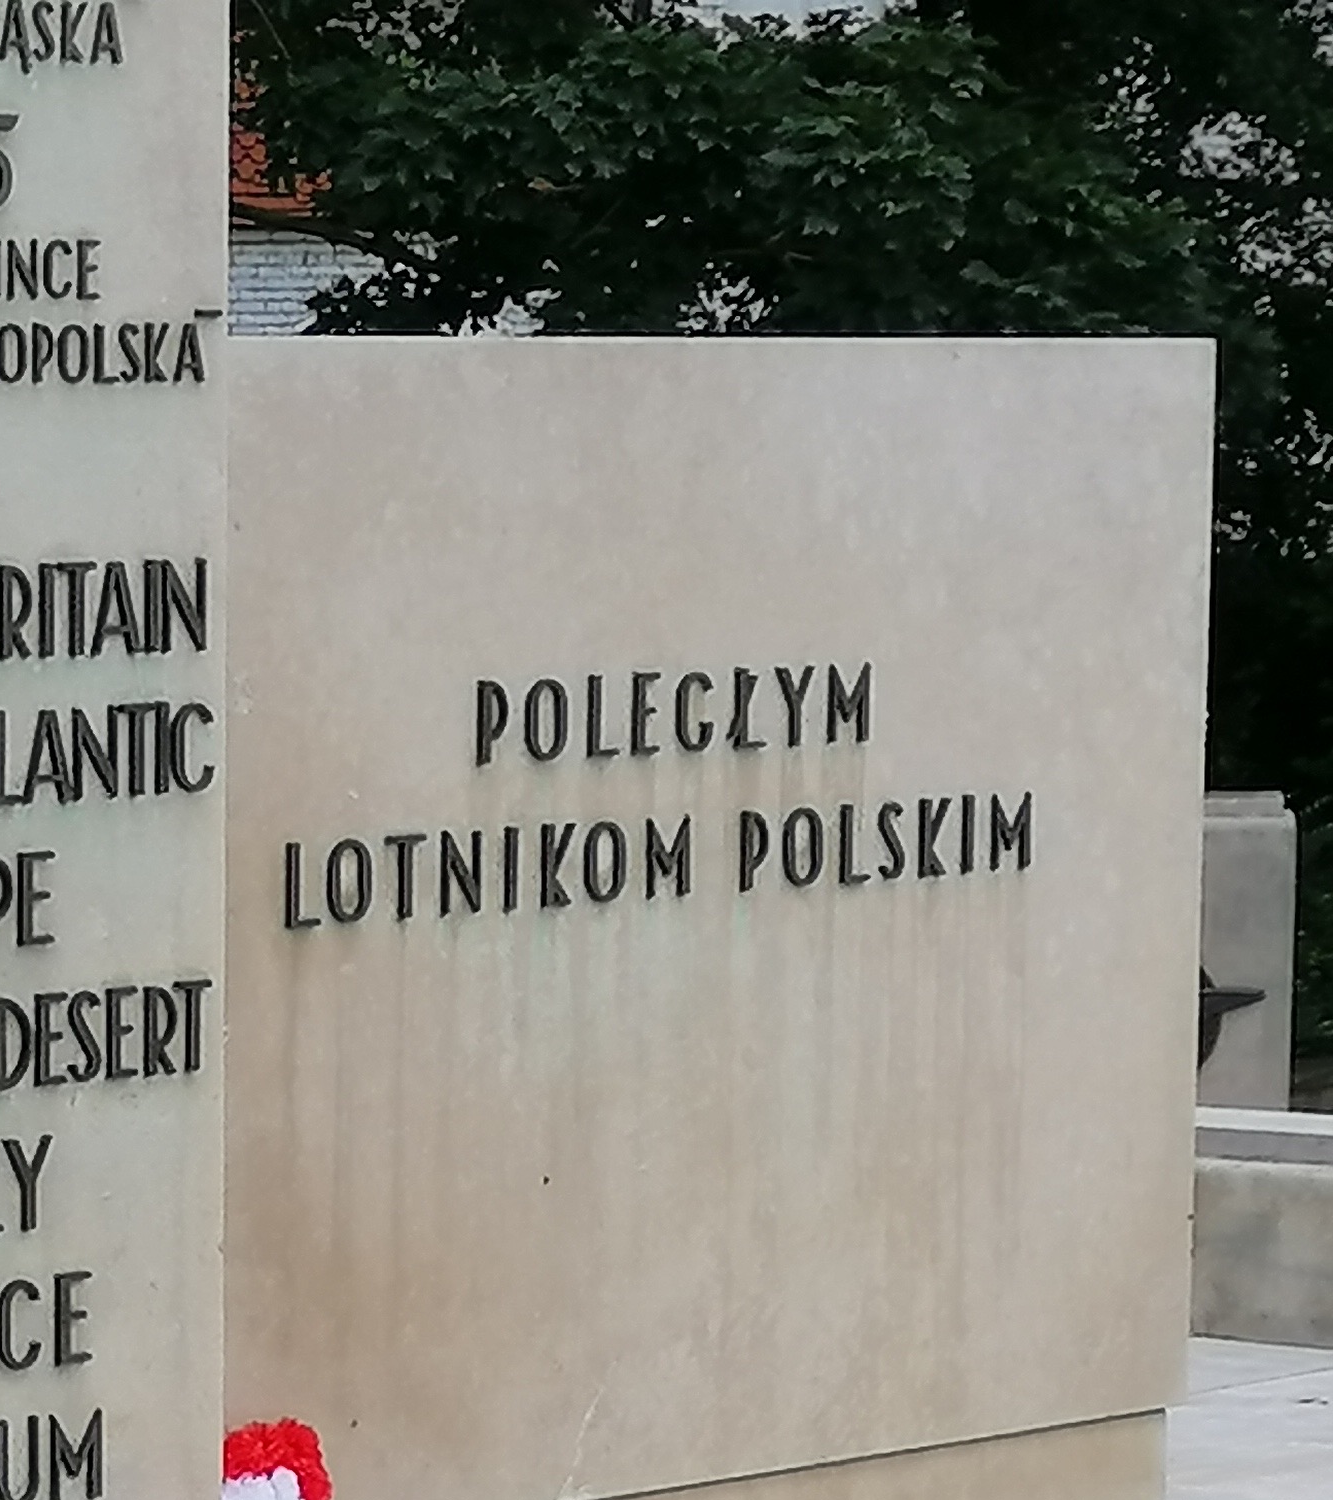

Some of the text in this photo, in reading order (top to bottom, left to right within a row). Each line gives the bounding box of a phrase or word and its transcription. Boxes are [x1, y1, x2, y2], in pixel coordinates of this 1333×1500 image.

[476, 662, 871, 768] POLEGŁYM
[284, 792, 1031, 932] LOTNIKOM POLSKIM
